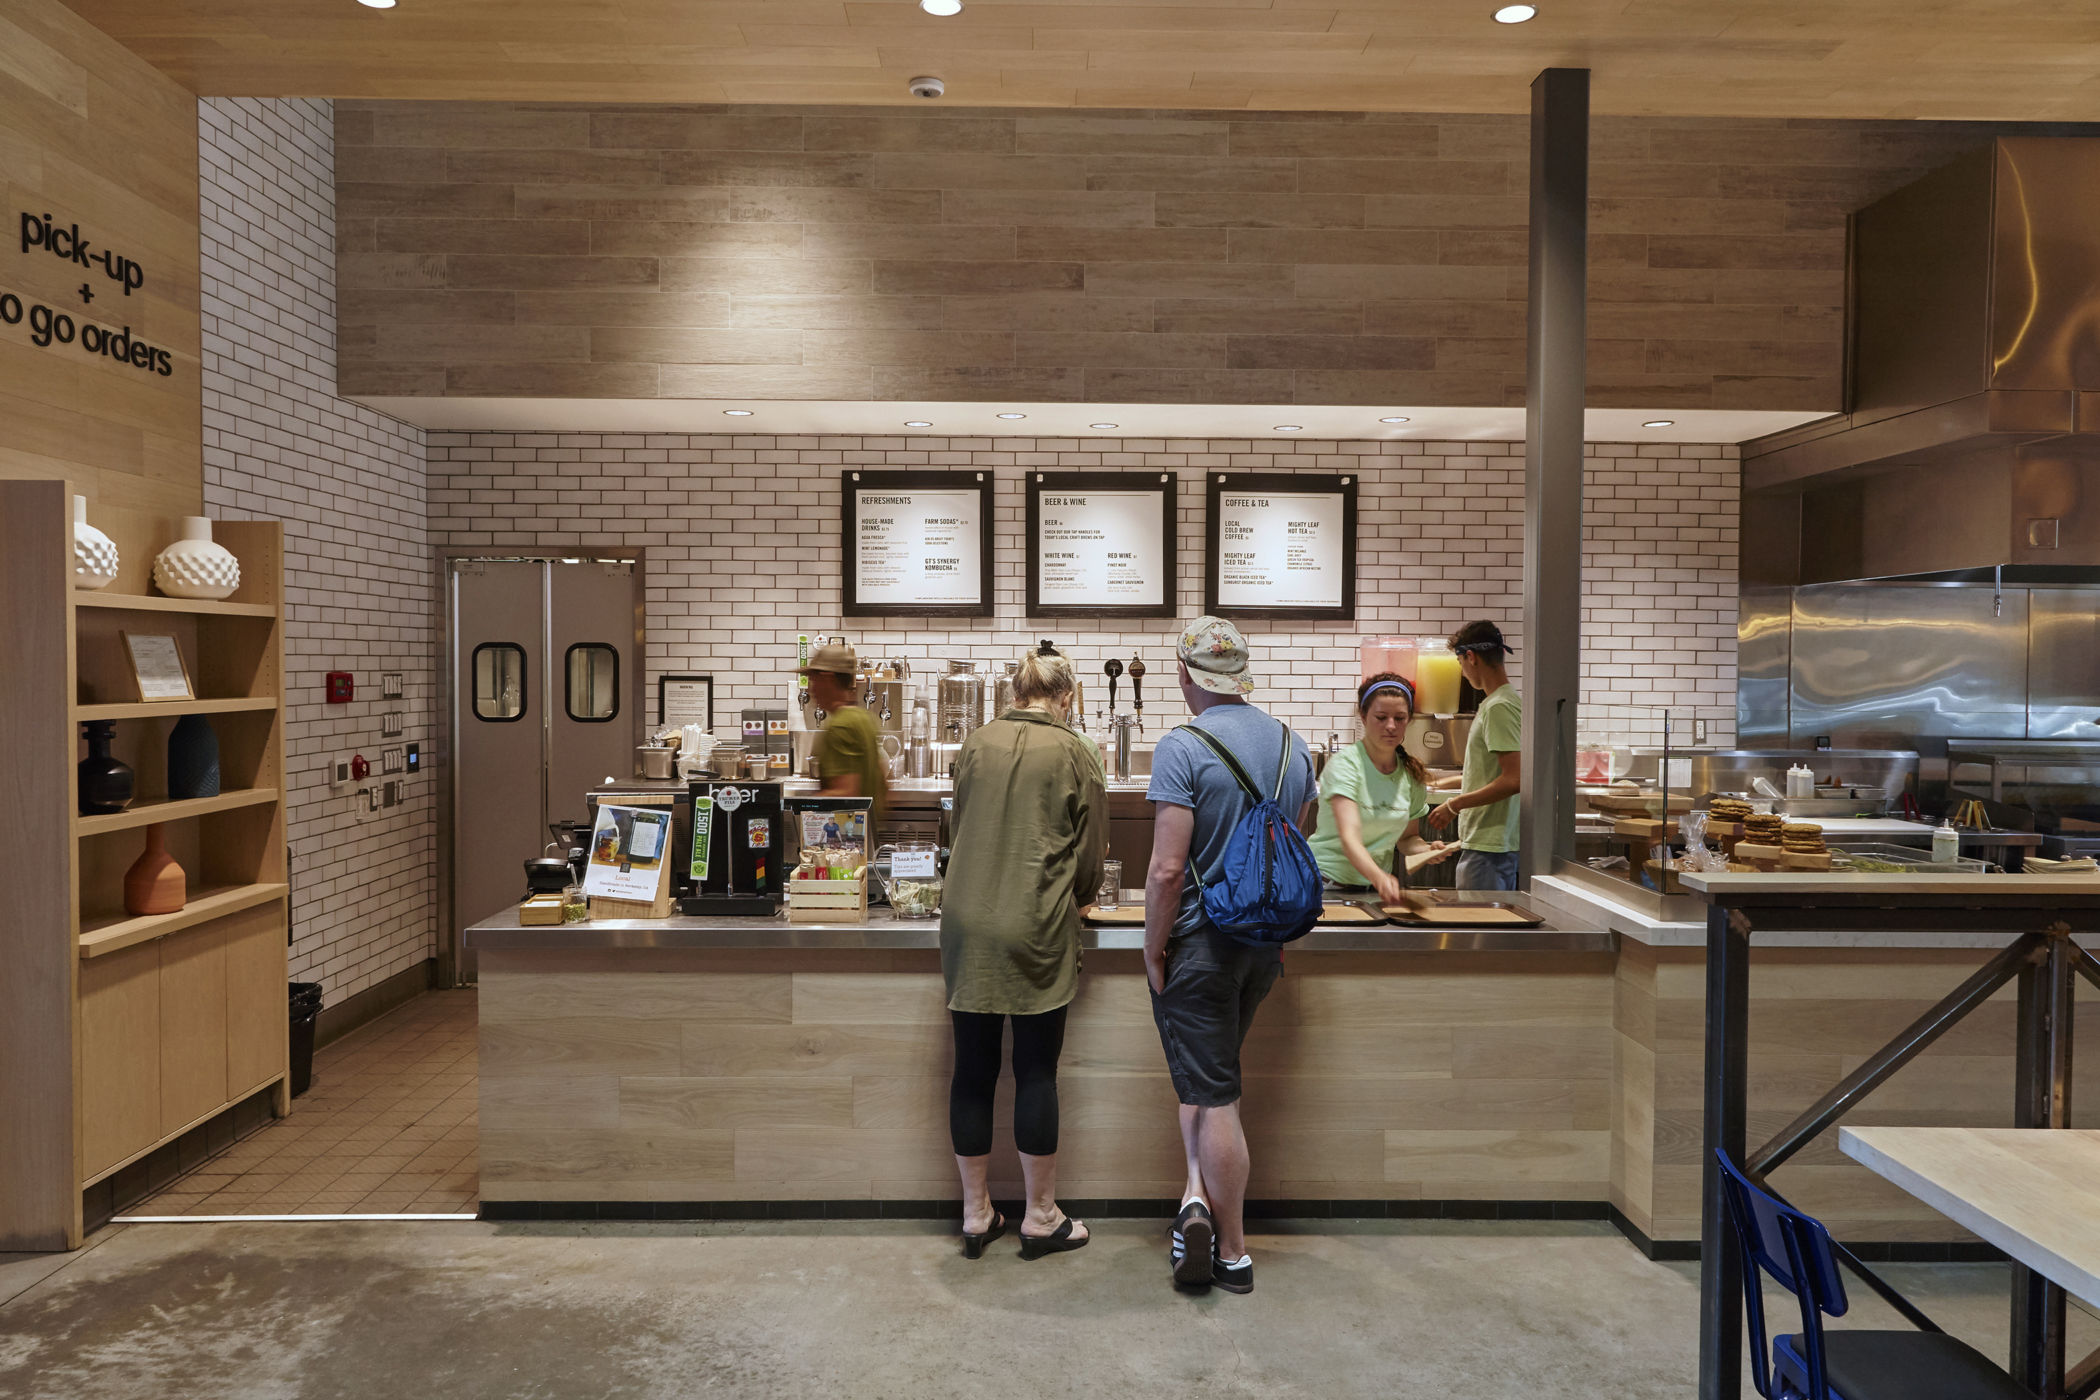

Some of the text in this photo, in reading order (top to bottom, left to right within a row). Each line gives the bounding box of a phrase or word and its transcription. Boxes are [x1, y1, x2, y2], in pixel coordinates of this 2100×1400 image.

[21, 211, 143, 296] pick-up
[0, 292, 172, 377] o go orders
[697, 812, 708, 834] 1500
